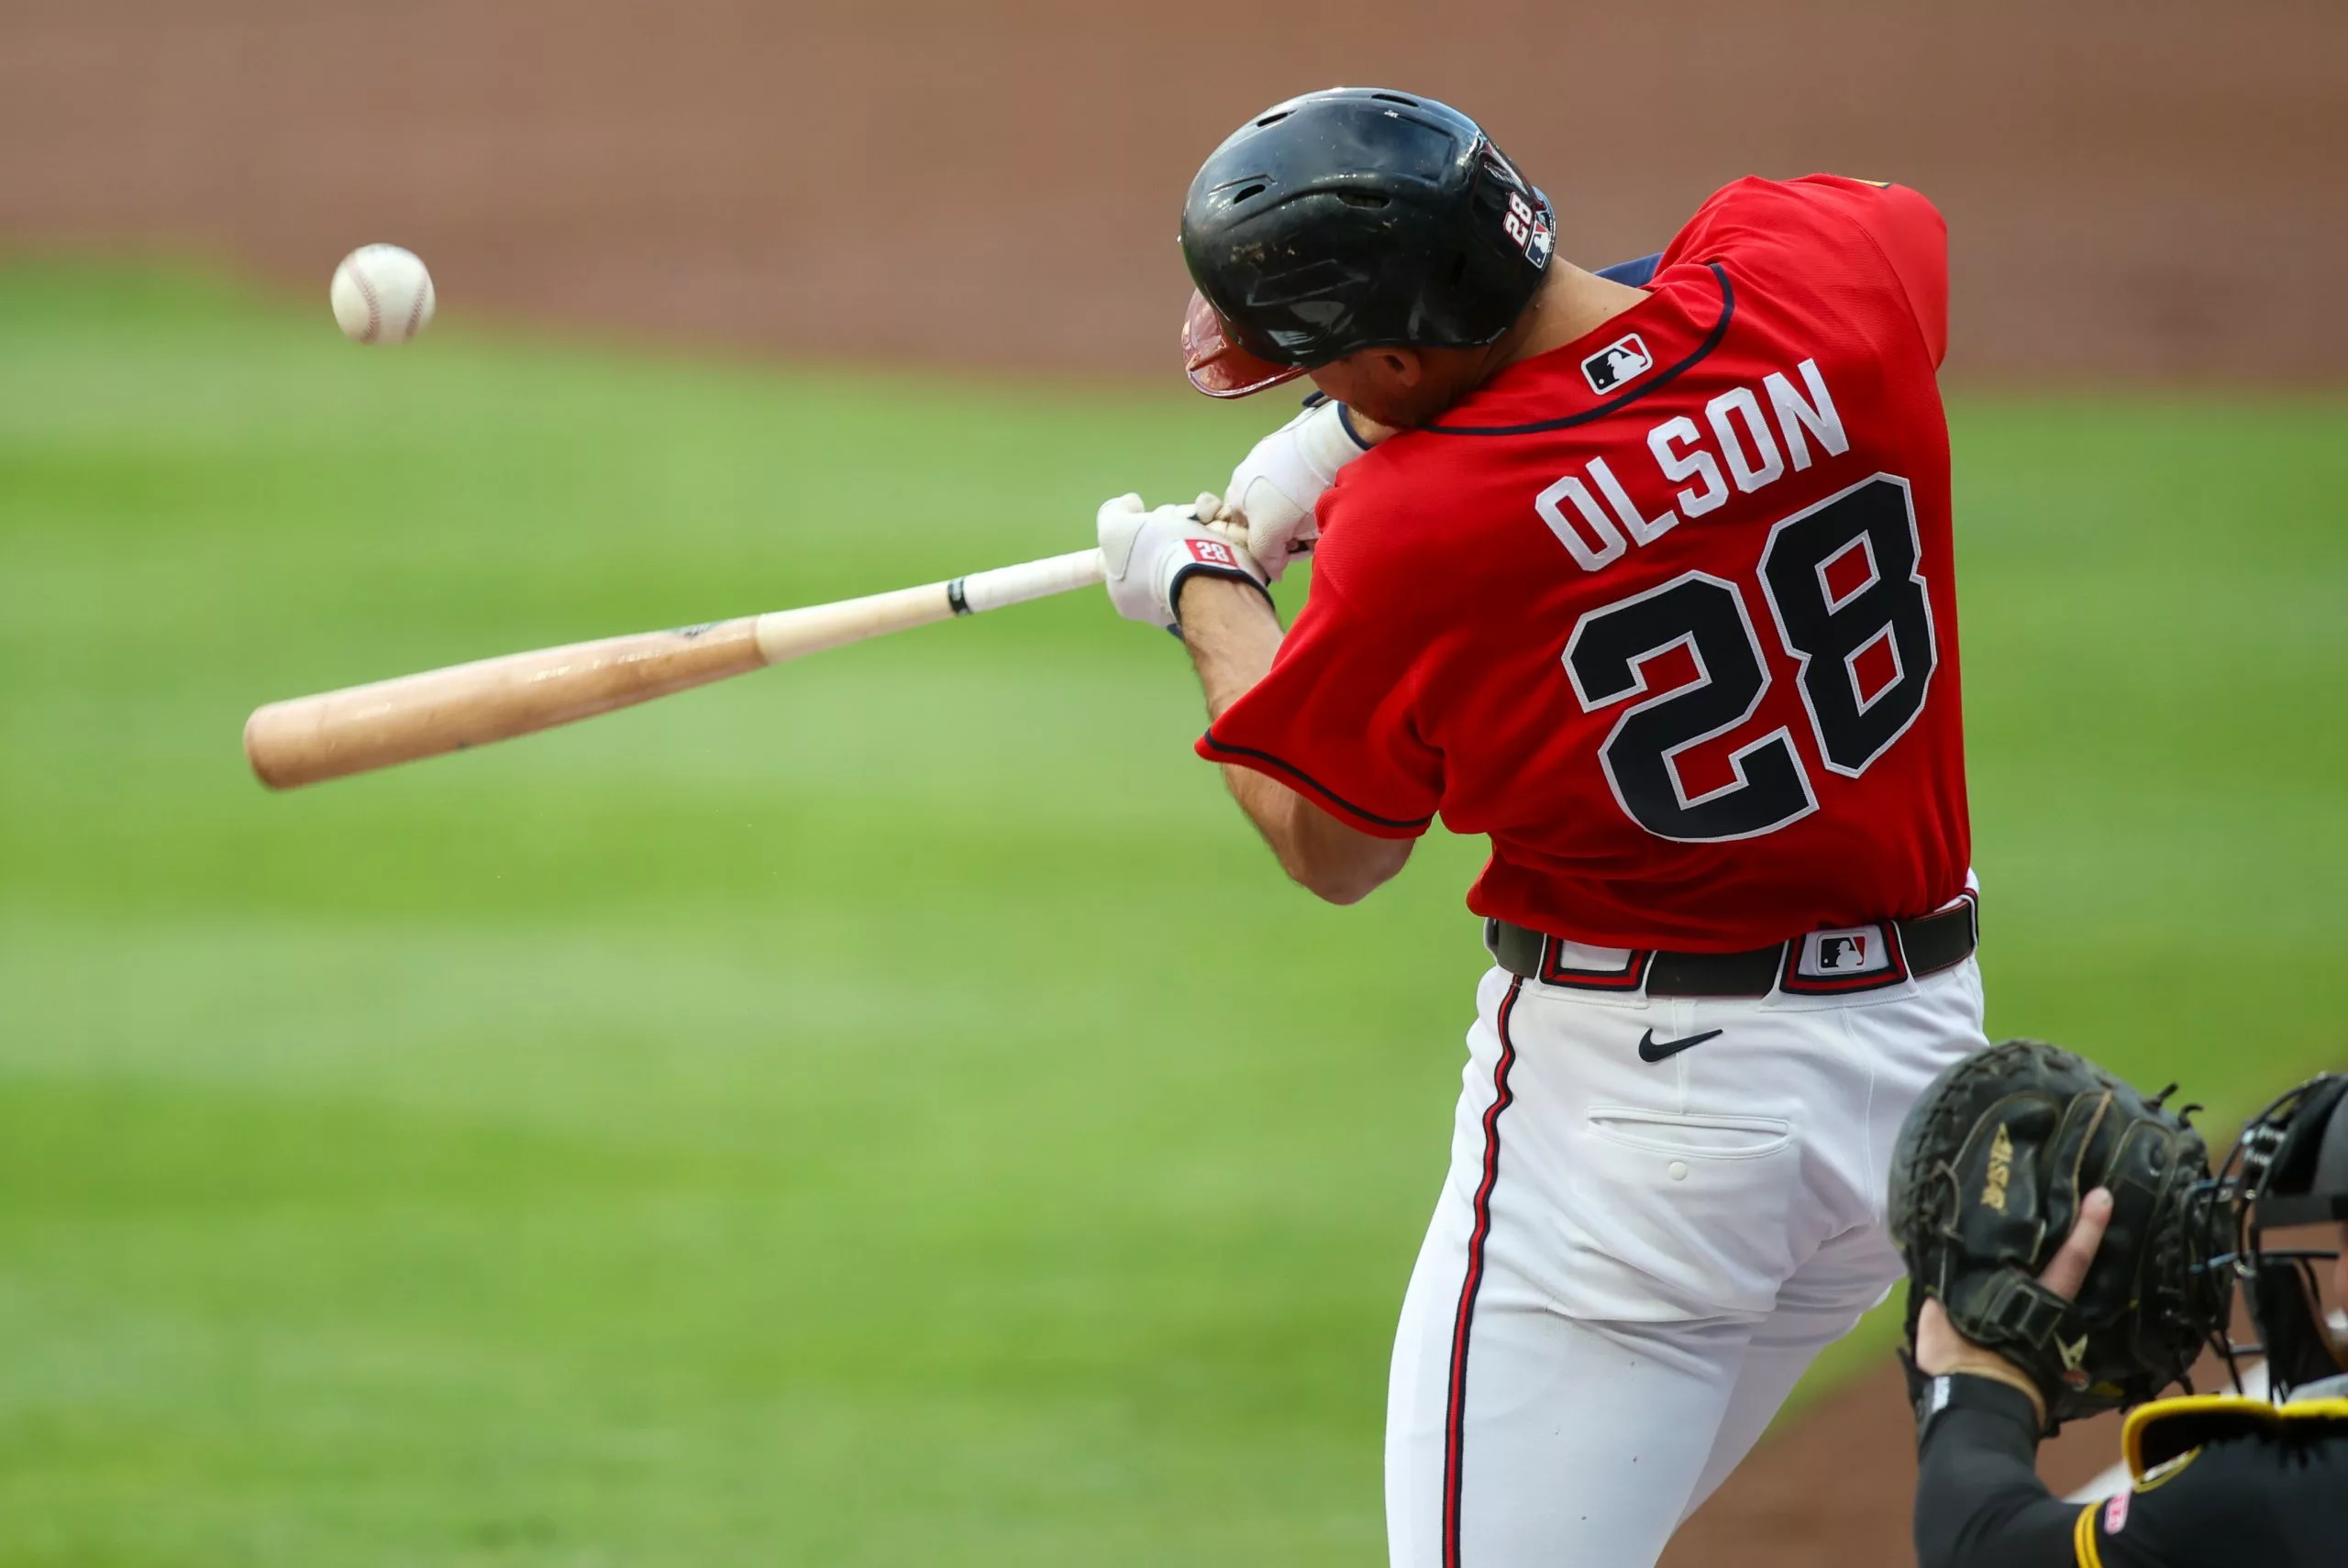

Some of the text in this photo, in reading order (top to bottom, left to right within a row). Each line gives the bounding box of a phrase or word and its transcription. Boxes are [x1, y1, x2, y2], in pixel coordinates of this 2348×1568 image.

[1504, 191, 1533, 248] 28
[1534, 358, 1850, 572] OLSON
[1195, 541, 1230, 563] 28
[1561, 471, 1938, 843] 28
